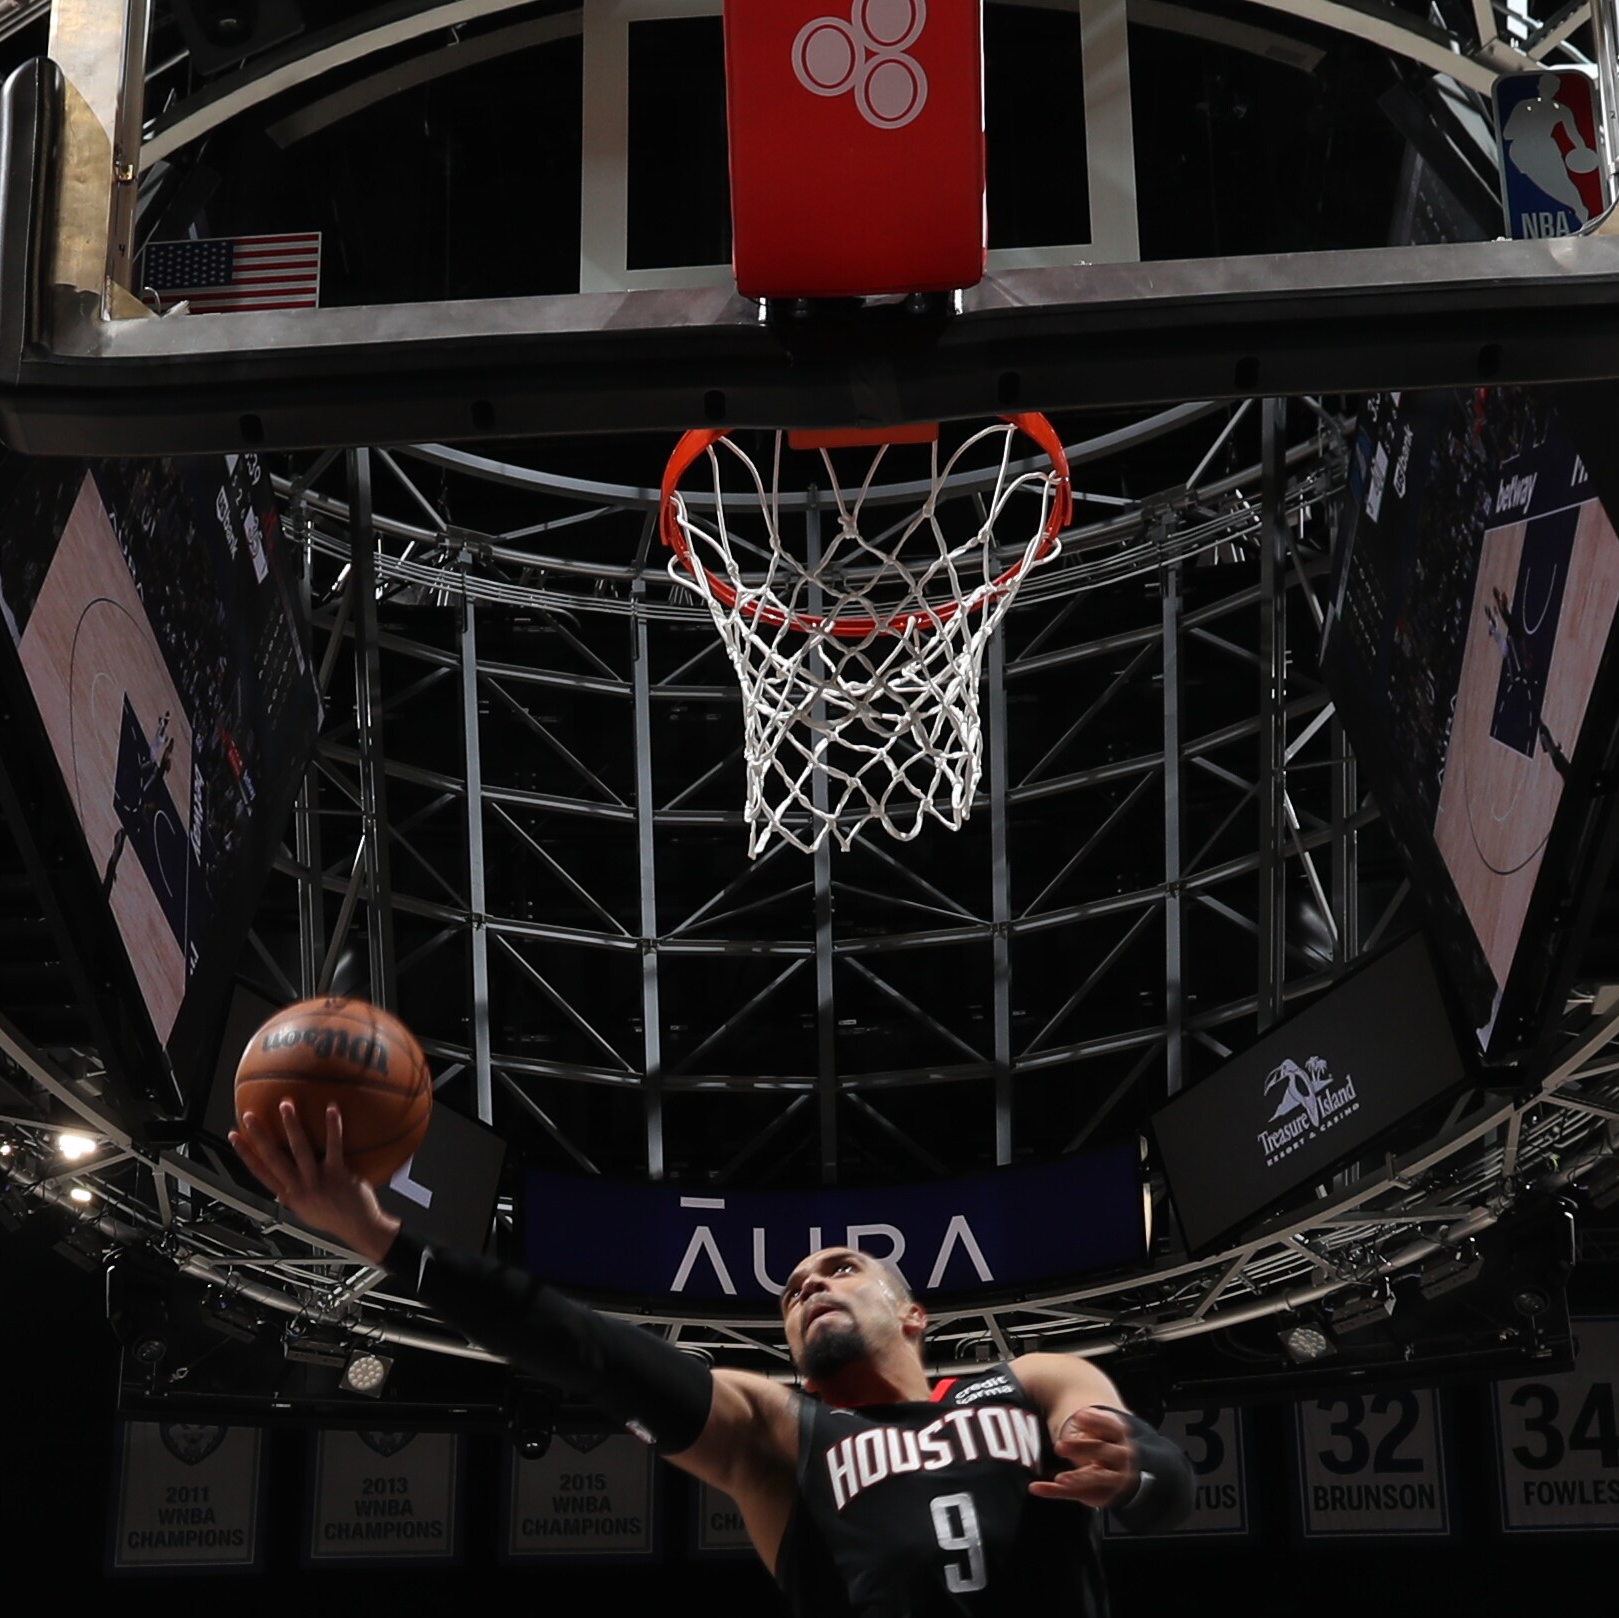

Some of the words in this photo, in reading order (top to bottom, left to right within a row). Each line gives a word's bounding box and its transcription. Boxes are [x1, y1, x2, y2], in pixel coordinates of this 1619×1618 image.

[1521, 211, 1570, 238] NBA
[1257, 1112, 1310, 1156] Treasure
[1316, 1074, 1357, 1119] Island
[954, 1375, 1010, 1399] credit
[1316, 1391, 1424, 1475] 32
[825, 1406, 1042, 1513] HOUSTON
[362, 1477, 408, 1495] 2013
[559, 1473, 606, 1492] 2015
[166, 1486, 209, 1504] 2011
[552, 1495, 612, 1514] WNBA
[1314, 1483, 1435, 1511] BRUNSON
[158, 1507, 216, 1526] WNBA
[355, 1499, 413, 1517] WNBA
[324, 1520, 442, 1540] CHAMPIONS
[522, 1516, 641, 1537] CHAMPIONS
[127, 1529, 244, 1549] CHAMPIONS
[929, 1491, 988, 1594] 9
